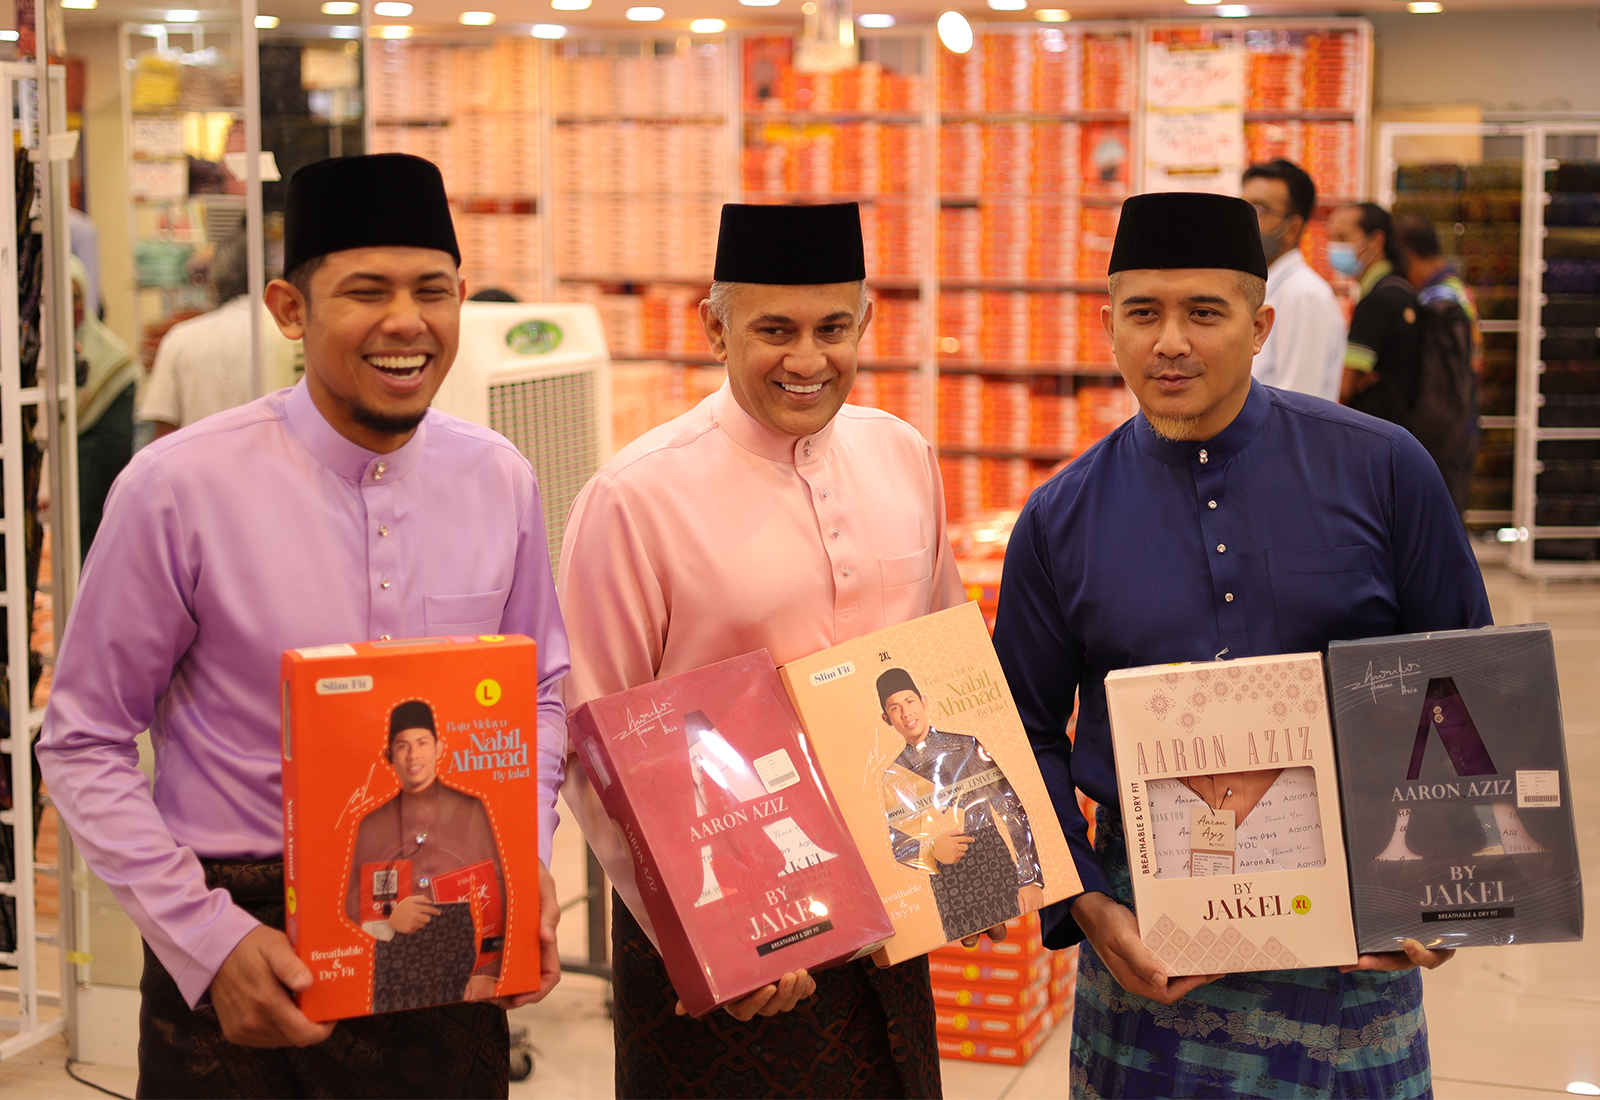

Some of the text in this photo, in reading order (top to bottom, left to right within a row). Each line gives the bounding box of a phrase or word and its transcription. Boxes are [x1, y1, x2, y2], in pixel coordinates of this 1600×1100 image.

[878, 651, 892, 662] 2XL
[814, 665, 851, 683] Slim Fit
[322, 680, 348, 691] Slim
[946, 669, 991, 698] Nabil
[484, 685, 493, 701] L
[937, 681, 1002, 719] Ahmad
[469, 727, 520, 753] Nabil
[446, 742, 529, 774] Ahmad
[1137, 726, 1313, 776] AARON AZIZ
[1131, 782, 1139, 793] FIT
[1391, 782, 1460, 802] AARON
[1467, 779, 1513, 798] AZIZ
[1133, 795, 1142, 812] DRY
[1283, 793, 1308, 802] Aaron
[690, 796, 788, 842] AARON AZIZ
[1196, 814, 1228, 826] Aaron
[1288, 824, 1313, 834] Aaron
[1137, 822, 1150, 875] BREATHABLE
[1239, 859, 1264, 867] Aaron
[1297, 859, 1321, 869] Aaron
[1450, 865, 1477, 880] BY
[765, 885, 788, 906] BY
[1233, 882, 1253, 895] BY
[1420, 881, 1514, 907] JAKEL
[890, 903, 921, 920] Dry Fit
[900, 899, 908, 908] &
[1202, 895, 1307, 921] JAKEL XL
[770, 934, 799, 950] BREATHABLE
[311, 945, 364, 961] Breathable
[332, 958, 342, 970] &
[319, 966, 355, 981] Dry Fit
